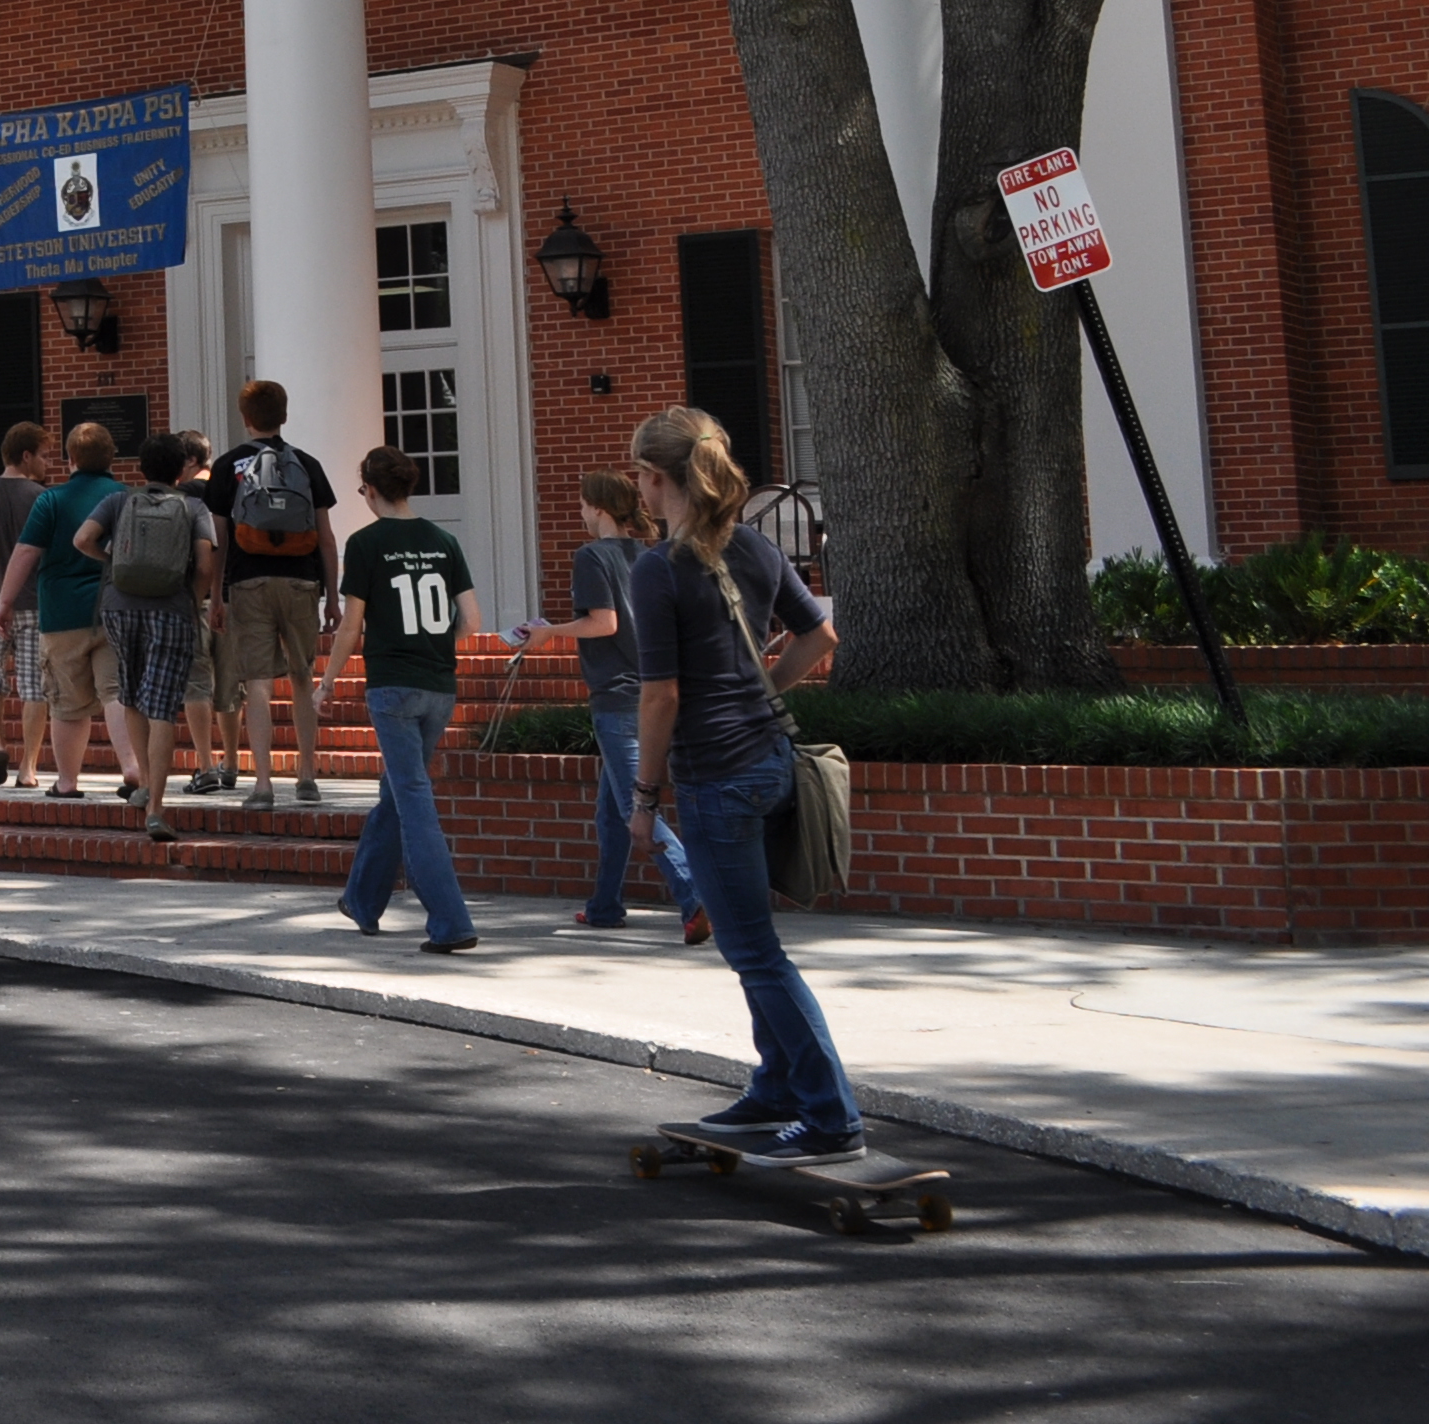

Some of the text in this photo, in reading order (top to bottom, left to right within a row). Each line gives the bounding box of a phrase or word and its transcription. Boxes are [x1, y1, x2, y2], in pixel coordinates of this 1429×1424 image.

[56, 100, 136, 137] KAPPA
[144, 92, 184, 122] PSI
[74, 136, 119, 153] BUSINESS
[122, 126, 181, 144] FRATERNITY
[133, 159, 166, 187] UNITY
[1002, 151, 1072, 189] FIRE LANE
[128, 165, 183, 210] EDUCATI
[1033, 185, 1061, 213] NO
[68, 224, 165, 252] UNIVERSITY
[1018, 203, 1096, 249] PARKING
[1029, 229, 1101, 267] TOW-AWAY
[25, 253, 138, 279] Theta Mu Chapter
[1051, 252, 1092, 278] ZONE
[390, 572, 451, 635] 10
